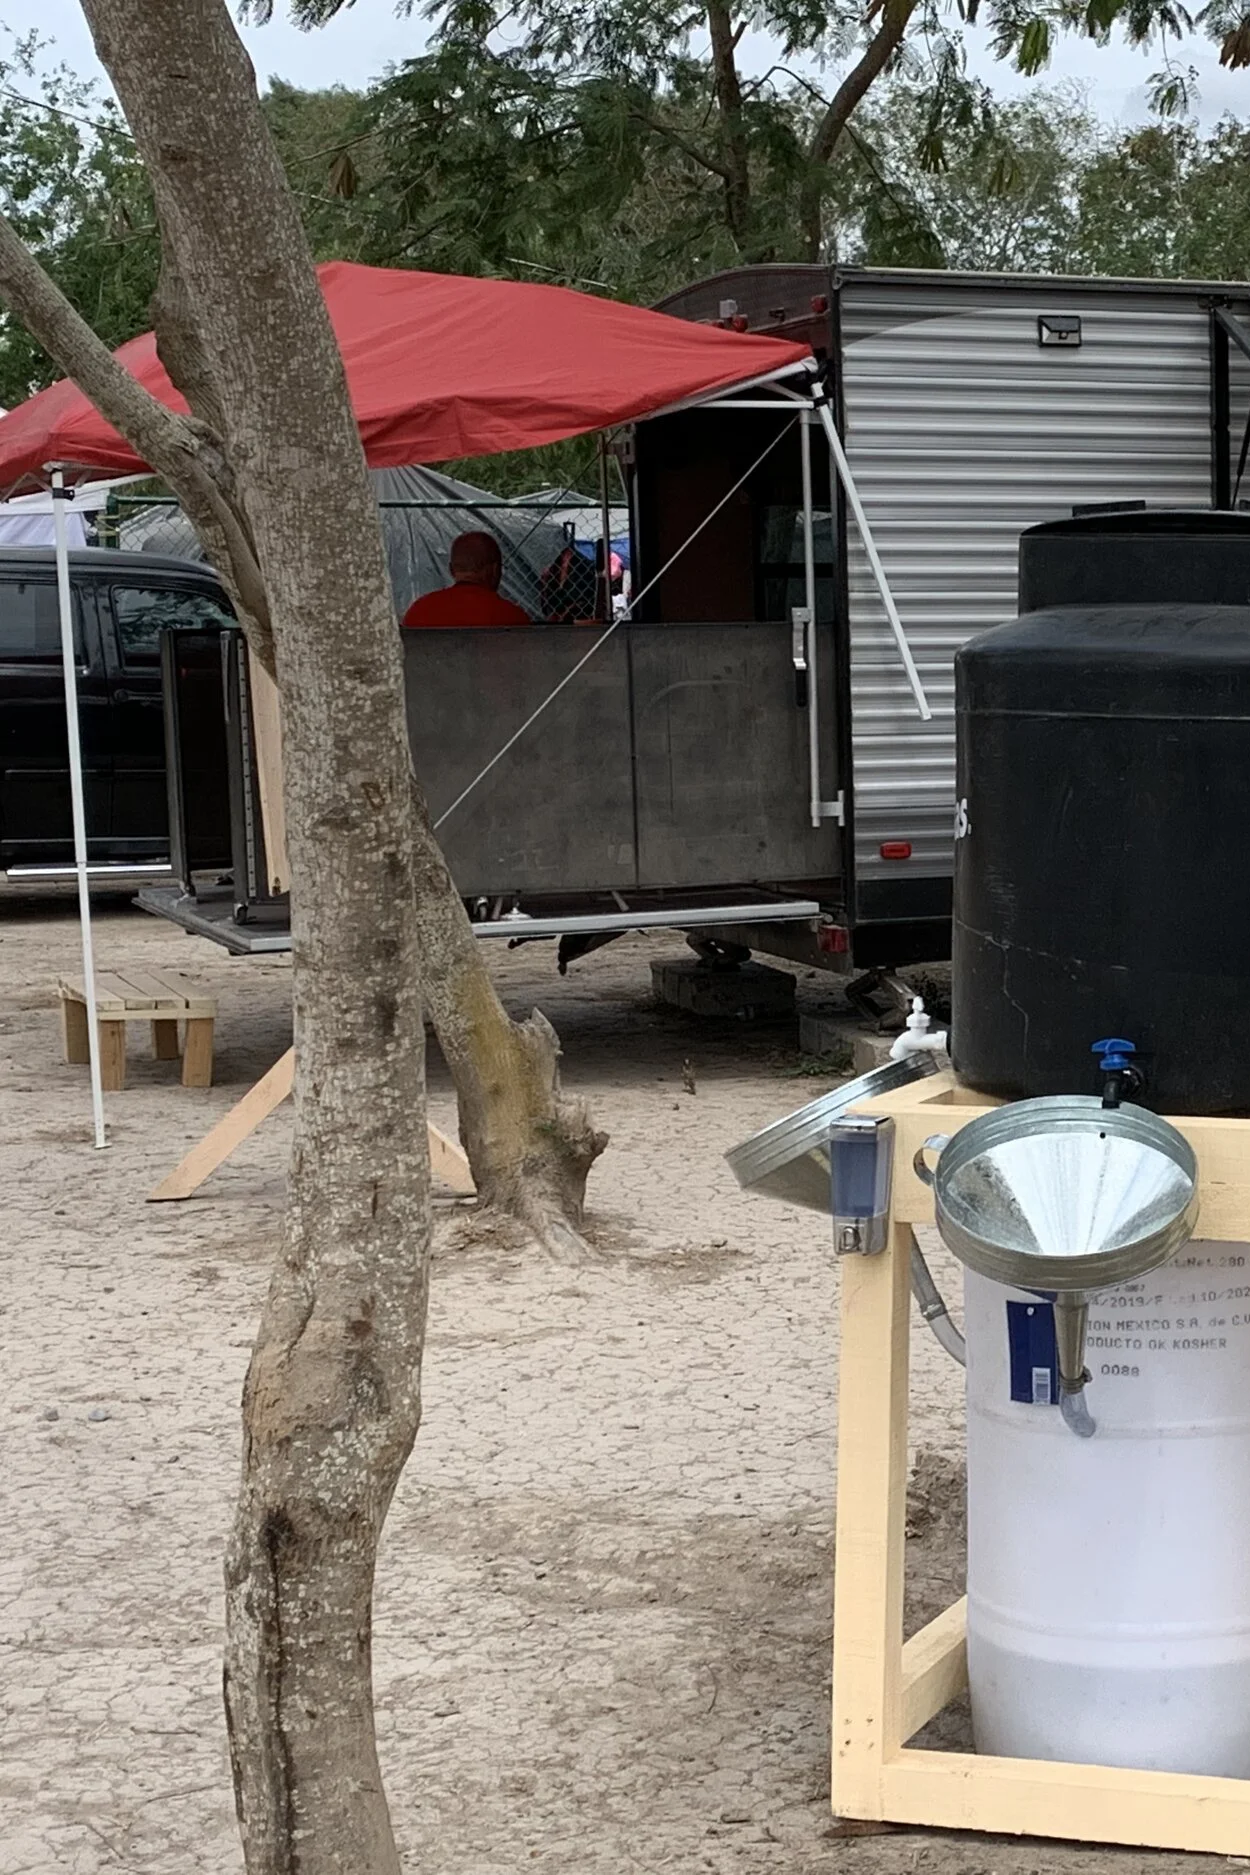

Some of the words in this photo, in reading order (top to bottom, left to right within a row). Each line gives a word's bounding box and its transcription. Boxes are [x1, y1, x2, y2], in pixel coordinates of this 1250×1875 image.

[1087, 1320, 1111, 1331] ION
[1116, 1319, 1171, 1331] MEXICO
[1087, 1336, 1142, 1350] ODUCTO
[1172, 1337, 1228, 1350] KOSHER
